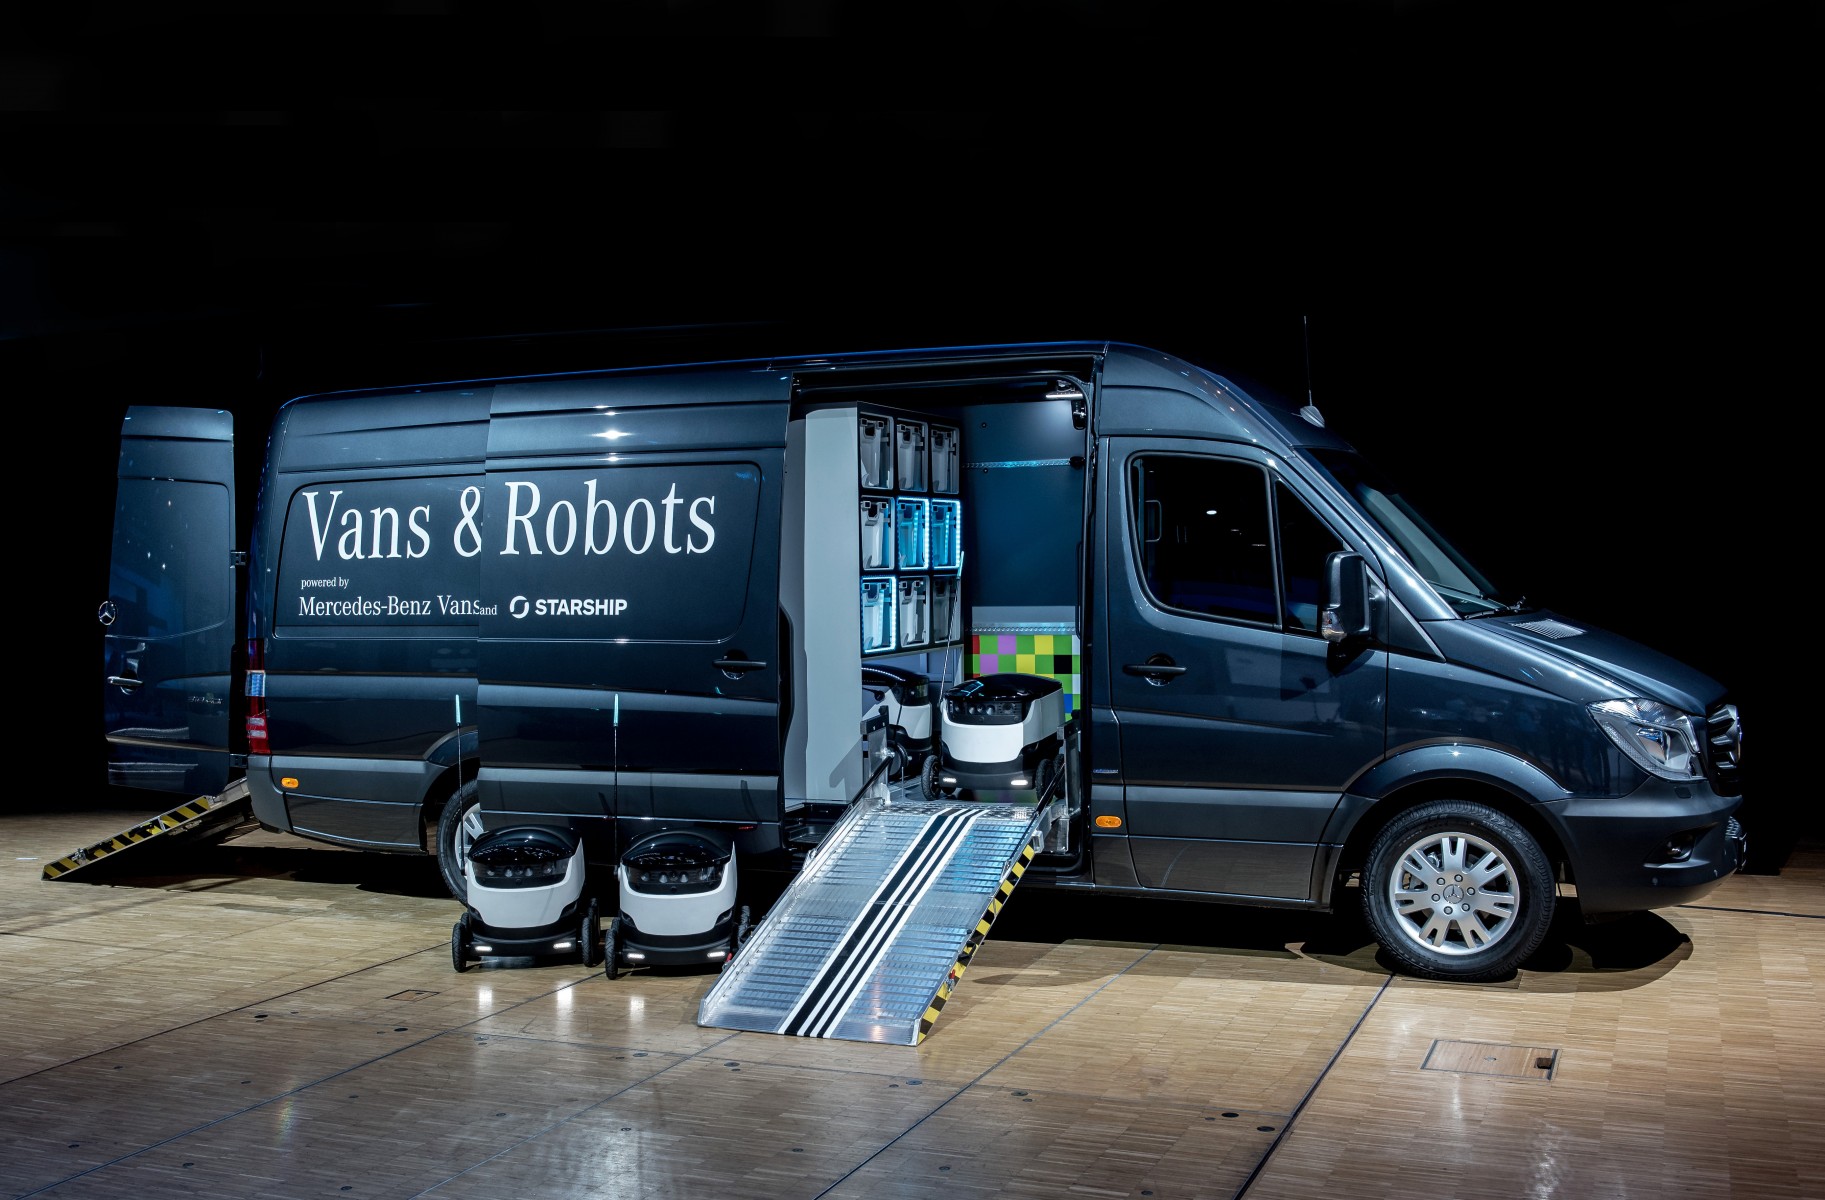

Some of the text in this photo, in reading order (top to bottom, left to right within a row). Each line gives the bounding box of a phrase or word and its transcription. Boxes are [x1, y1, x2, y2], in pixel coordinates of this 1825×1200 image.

[302, 479, 716, 561] Vans & Robots
[301, 577, 350, 590] powered by
[299, 595, 628, 616] Mercedes-Benz Vans and STARSHIP
